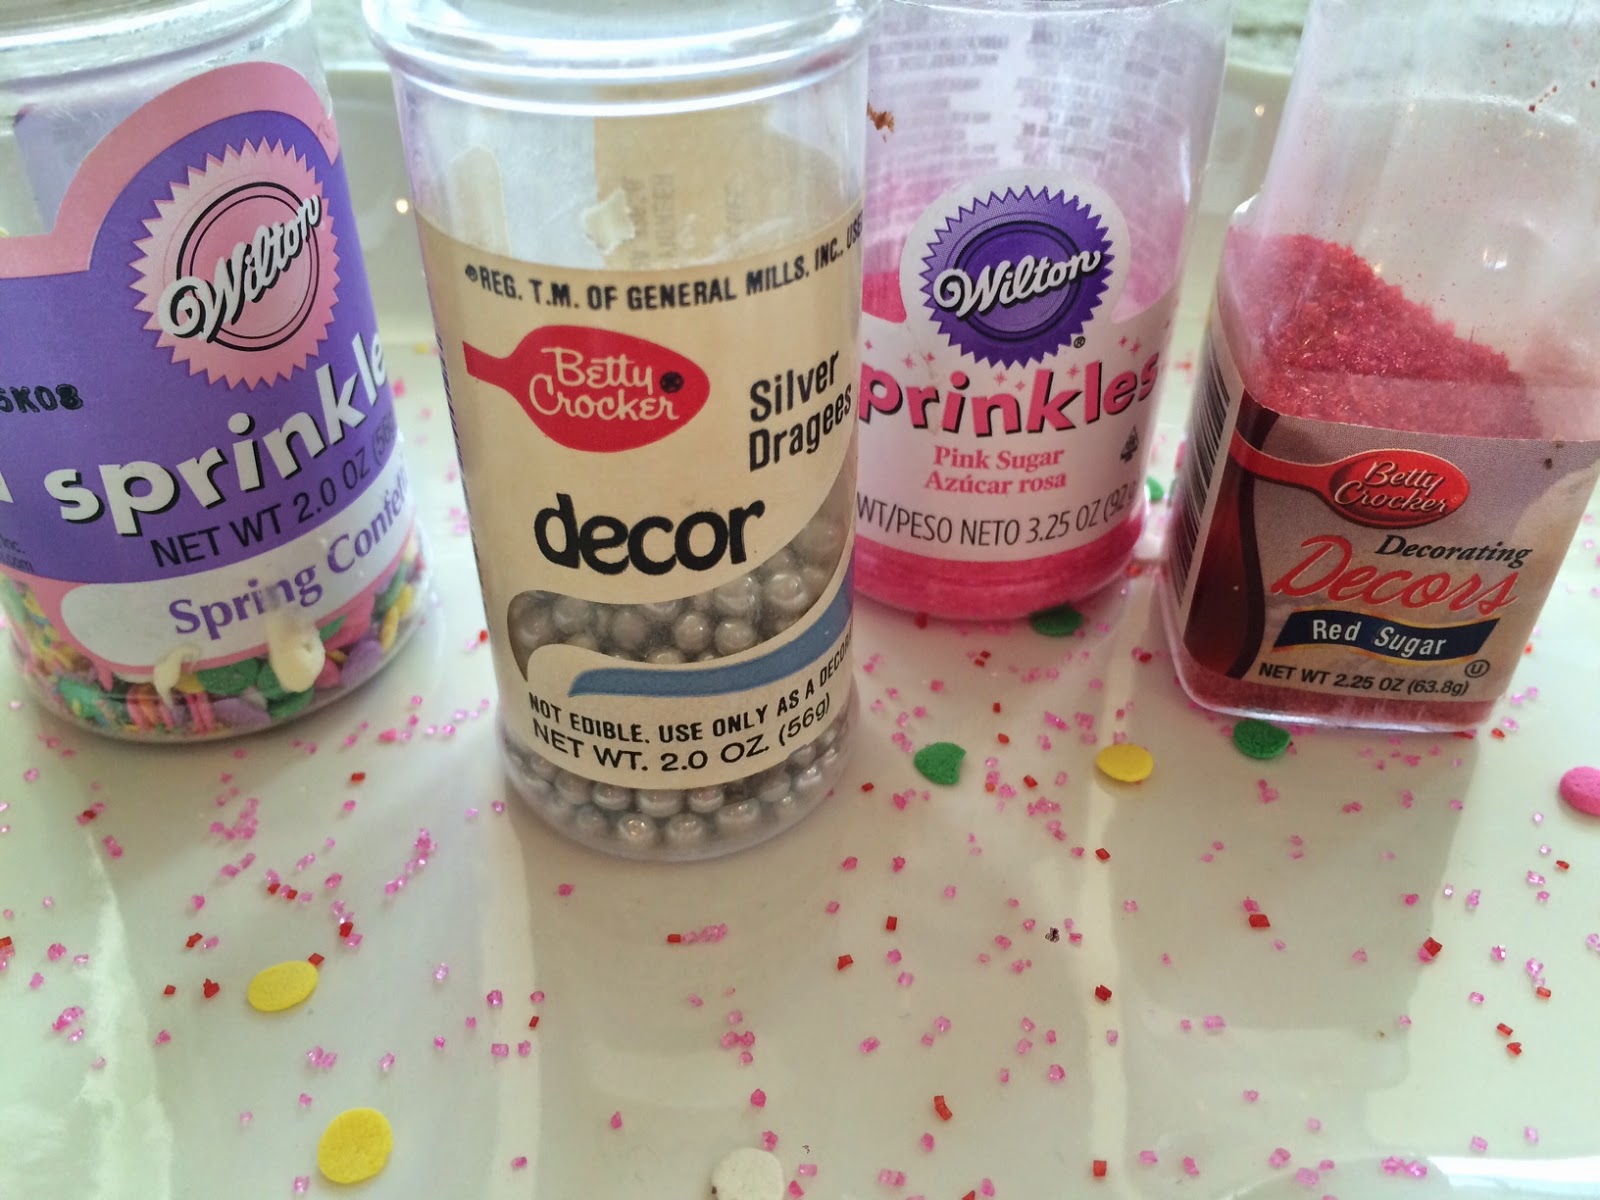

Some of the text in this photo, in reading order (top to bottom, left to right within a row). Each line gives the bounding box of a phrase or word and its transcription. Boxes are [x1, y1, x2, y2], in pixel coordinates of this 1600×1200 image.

[157, 194, 322, 342] Wilton
[529, 279, 580, 308] T.M.
[587, 285, 618, 310] OF
[627, 277, 736, 311] GENERAL
[933, 250, 1101, 317] Wilton
[530, 374, 679, 420] Crocker
[541, 347, 653, 399] Betty
[750, 351, 840, 423] Silver
[750, 384, 852, 472] Dragees
[925, 469, 1066, 494] Azúcar rosa
[934, 446, 1064, 472] Pink Sugar
[1364, 461, 1445, 498] Betty
[151, 526, 220, 567] NET
[229, 504, 284, 548] WT
[296, 477, 337, 524] 2.0
[343, 446, 370, 489] OZ
[857, 492, 952, 543] WT/PESO
[961, 519, 1021, 546] NETO
[1026, 513, 1069, 543] 3.25
[1076, 499, 1101, 531] OZ
[1334, 480, 1447, 513] Crocker
[534, 493, 765, 575] decor
[1375, 534, 1533, 569] Decorating
[1271, 534, 1521, 615] Decors
[169, 564, 323, 641] Spring
[1312, 619, 1446, 658] Red Sugar
[1258, 662, 1469, 696] NET WT 2.25 OZ (63.8g)
[528, 692, 562, 723] NOT
[570, 713, 650, 743] EDIBLE.
[659, 722, 703, 743] USE
[712, 704, 768, 736] ONLY
[777, 689, 799, 717] AS
[805, 678, 815, 700] A
[533, 718, 584, 758] NET
[593, 744, 648, 771] WT.
[661, 750, 708, 771] 2.0
[779, 692, 830, 746] (56g)
